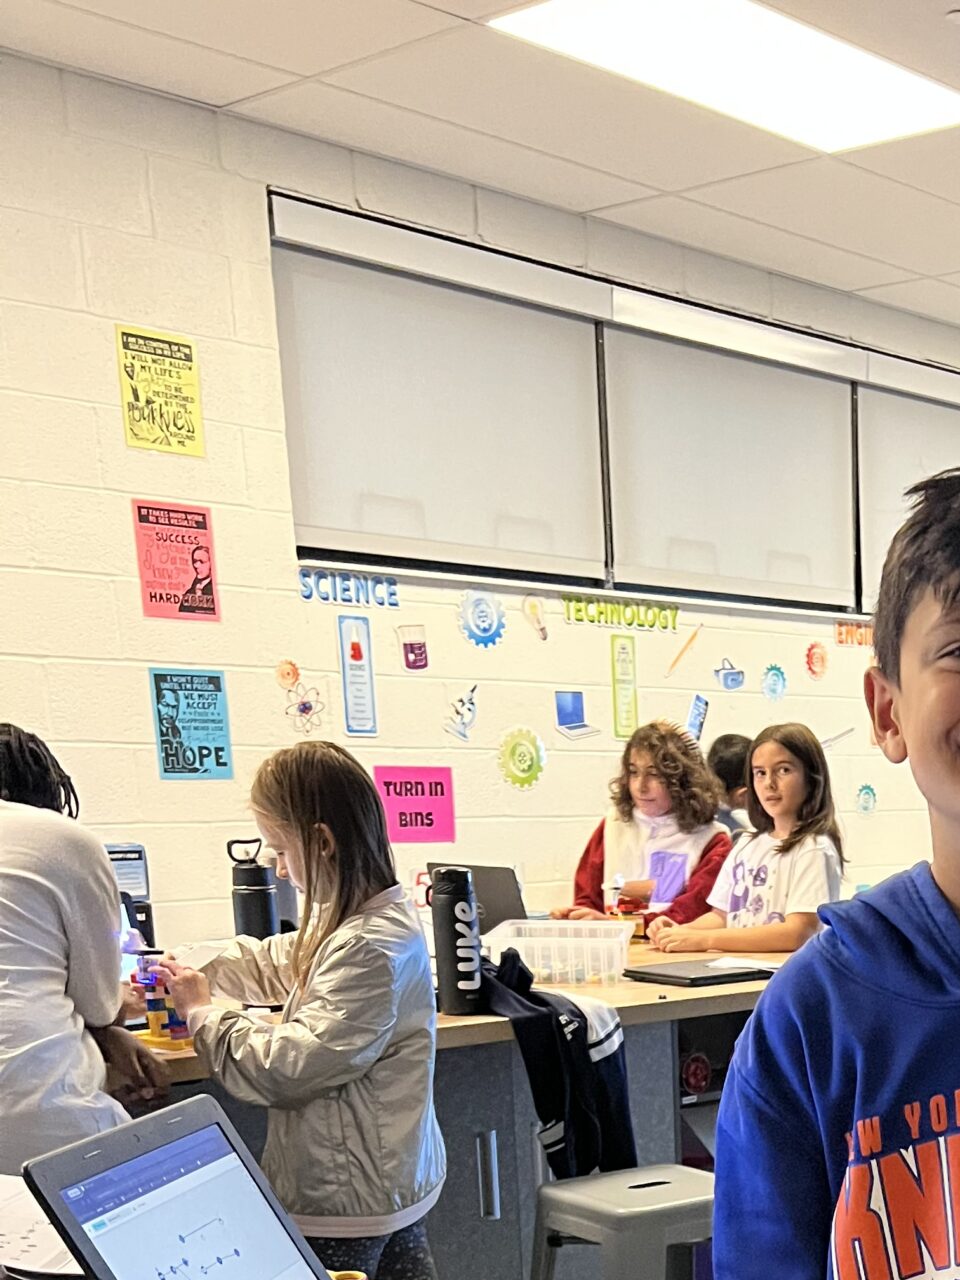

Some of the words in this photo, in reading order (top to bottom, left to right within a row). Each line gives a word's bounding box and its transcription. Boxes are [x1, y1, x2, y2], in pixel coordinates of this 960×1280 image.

[131, 354, 149, 364] WILL
[151, 356, 166, 366] NOT
[169, 360, 193, 371] ALLOW
[140, 364, 152, 373] MY
[155, 531, 201, 546] SUCCESS
[298, 567, 400, 608] SCIENCE
[149, 591, 180, 605] HARD
[562, 595, 680, 631] TECHNOLOGY
[183, 692, 196, 701] WE
[197, 693, 218, 702] MUST
[186, 701, 217, 711] ACCEPT
[163, 744, 229, 769] HOPE
